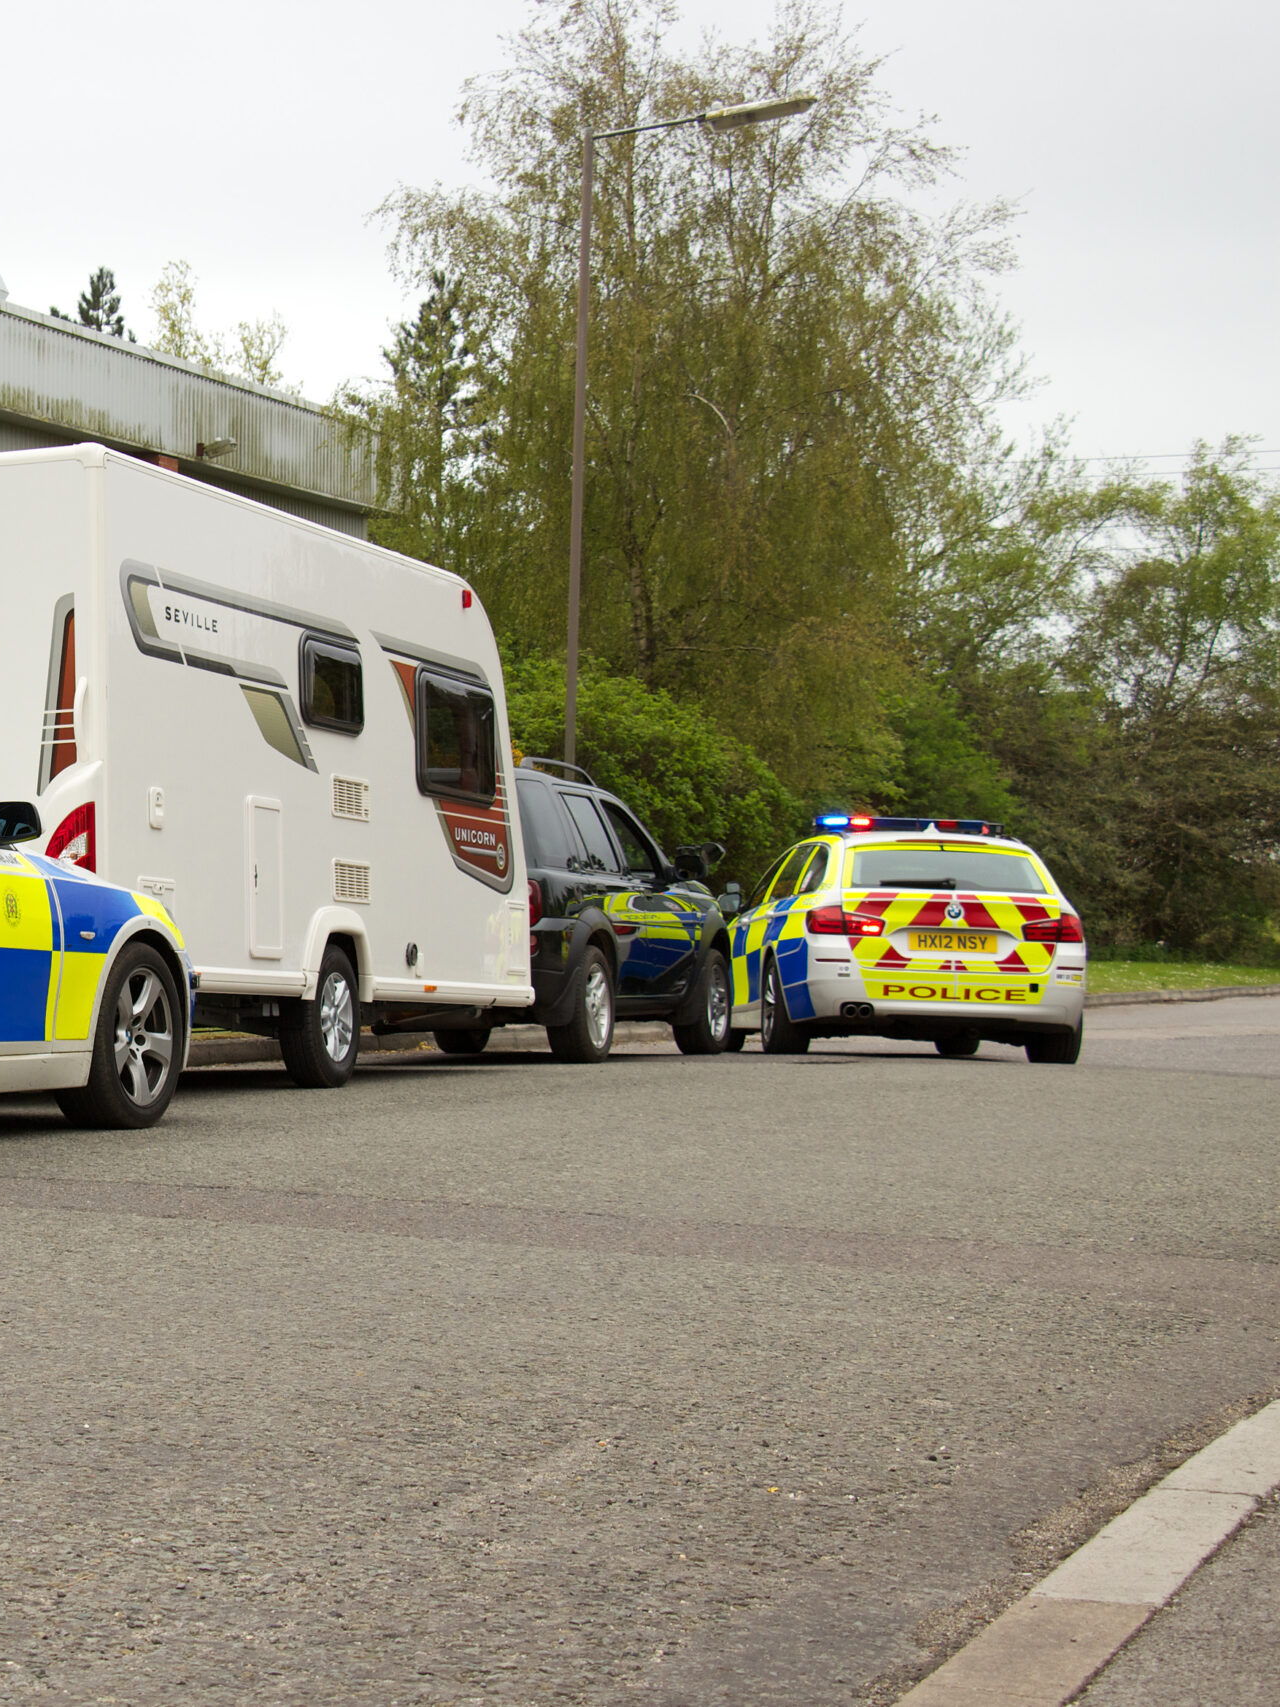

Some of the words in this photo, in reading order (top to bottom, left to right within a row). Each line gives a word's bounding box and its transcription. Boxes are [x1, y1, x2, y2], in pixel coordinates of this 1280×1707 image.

[165, 605, 218, 633] SEVILLE
[454, 826, 496, 846] UNICORN
[917, 934, 953, 949] HX12
[957, 935, 988, 950] NSY
[882, 984, 1027, 1002] POLICE
